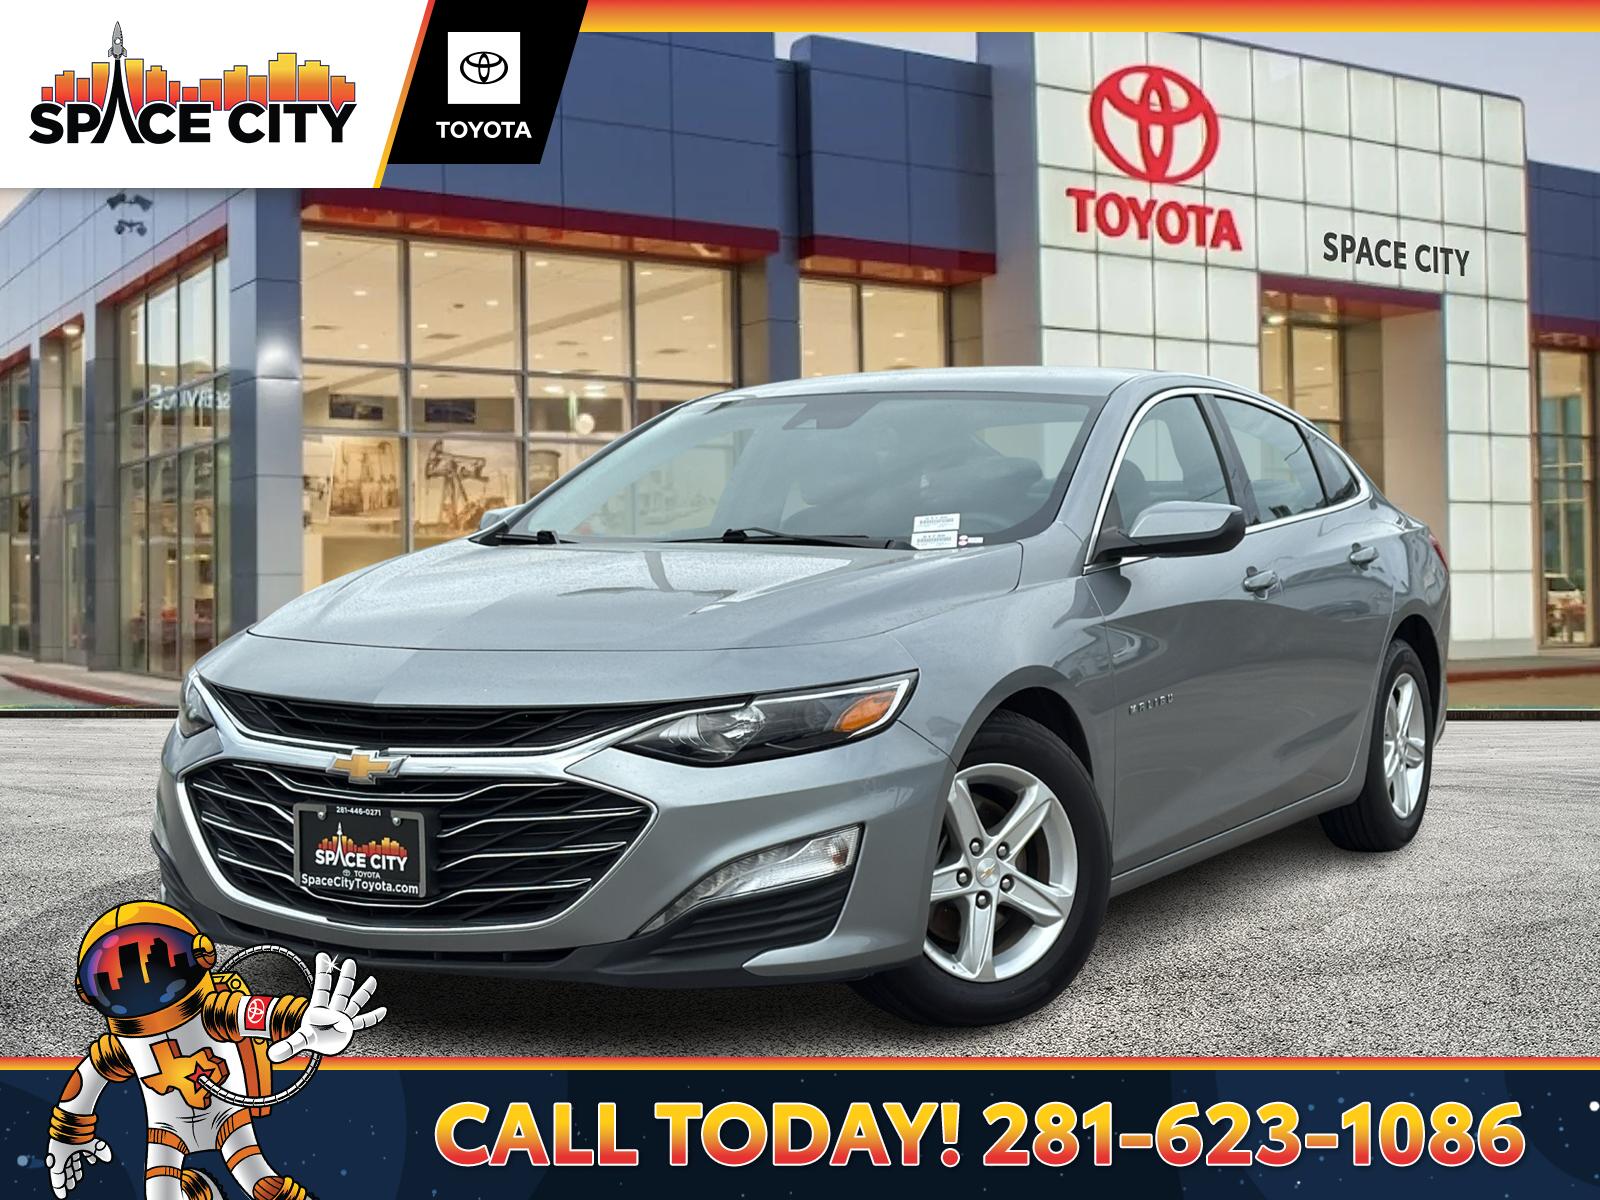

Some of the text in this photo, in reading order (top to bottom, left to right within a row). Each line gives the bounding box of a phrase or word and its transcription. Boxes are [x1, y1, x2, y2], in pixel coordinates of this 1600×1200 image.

[1066, 187, 1243, 251] TOYOTA
[1323, 231, 1470, 277] SPACE CITY
[336, 806, 381, 816] 281-446-0271
[315, 843, 408, 872] SPACE CITY
[301, 873, 419, 895] SpaceCityToyota.com
[354, 870, 381, 879] TOYOTA
